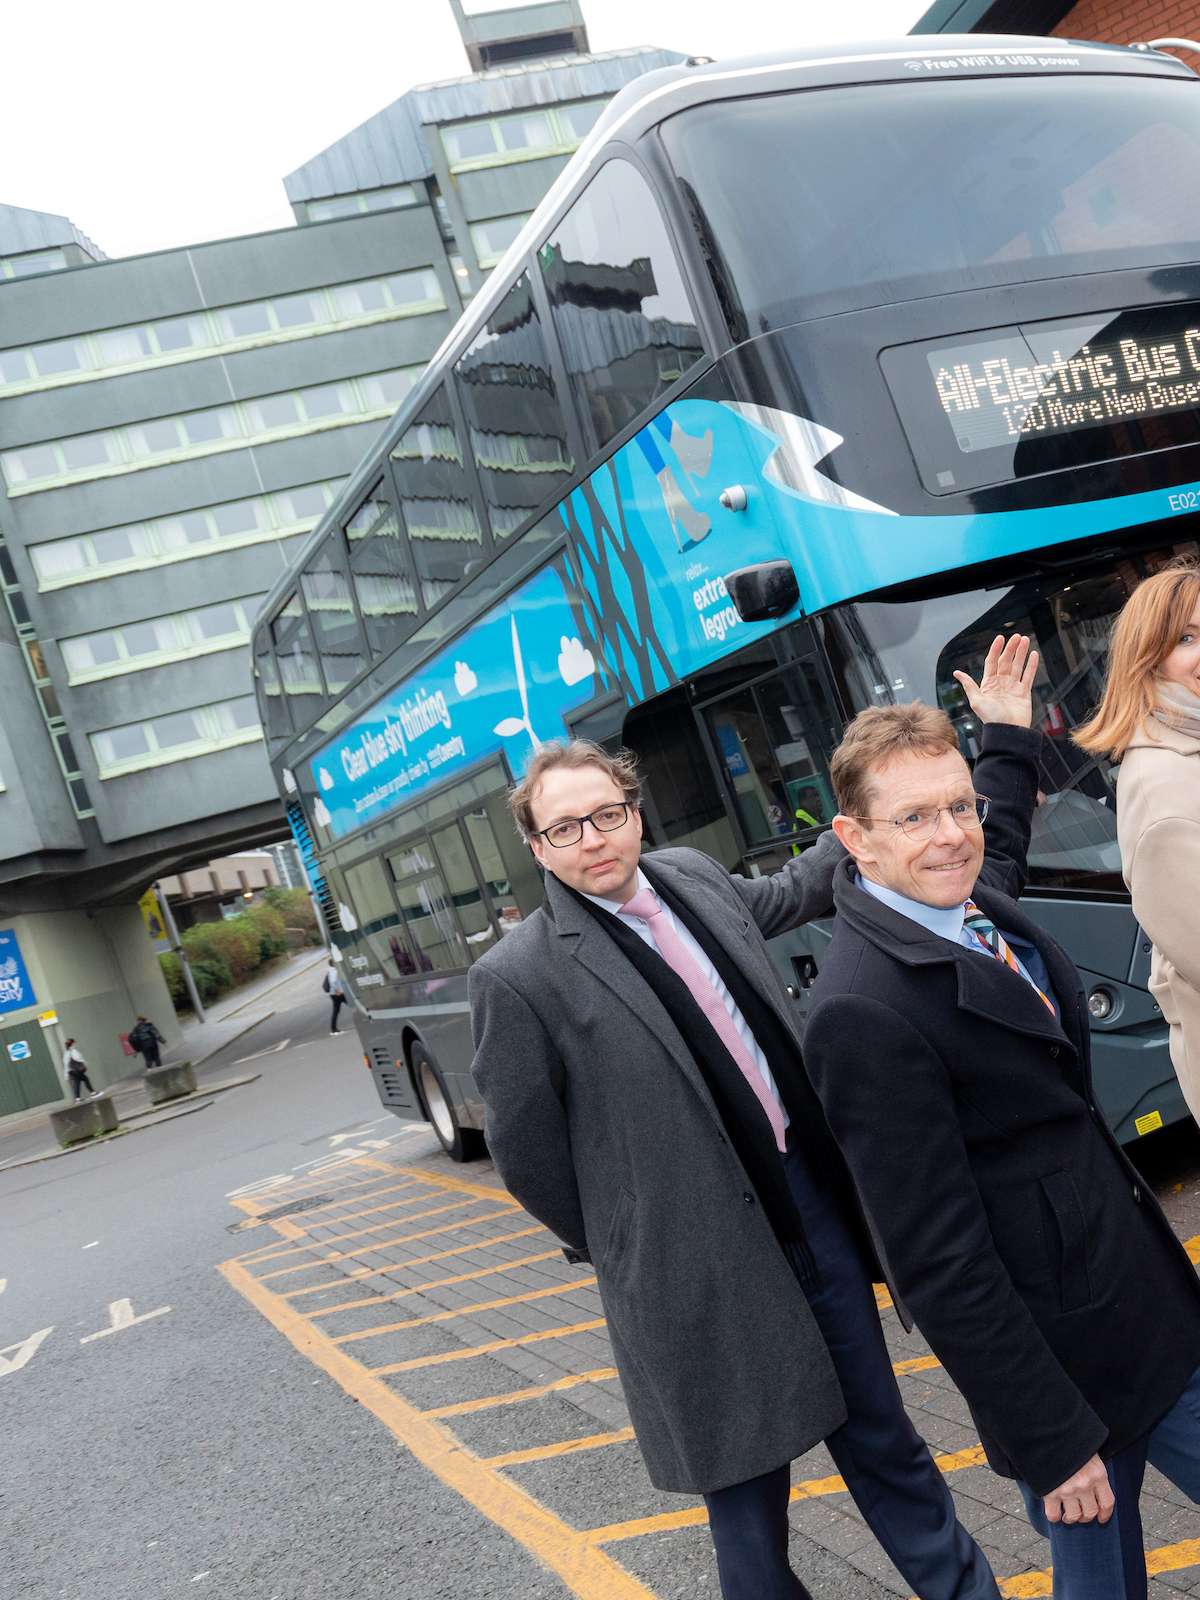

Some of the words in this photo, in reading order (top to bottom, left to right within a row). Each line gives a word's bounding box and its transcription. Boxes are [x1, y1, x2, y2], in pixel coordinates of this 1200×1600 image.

[923, 59, 958, 70] Free
[956, 55, 994, 67] WiFi
[994, 56, 1006, 66] &
[1008, 55, 1037, 65] USB
[1038, 56, 1080, 67] power
[935, 345, 1118, 413] All-Electric
[1119, 338, 1182, 382] Bus
[1046, 398, 1104, 427] More
[1102, 388, 1147, 417] New
[685, 562, 709, 582] relax...
[693, 576, 728, 611] extra
[340, 746, 369, 782] Clear
[360, 730, 389, 768] blue
[384, 716, 408, 757] sky
[399, 687, 452, 742] thinking
